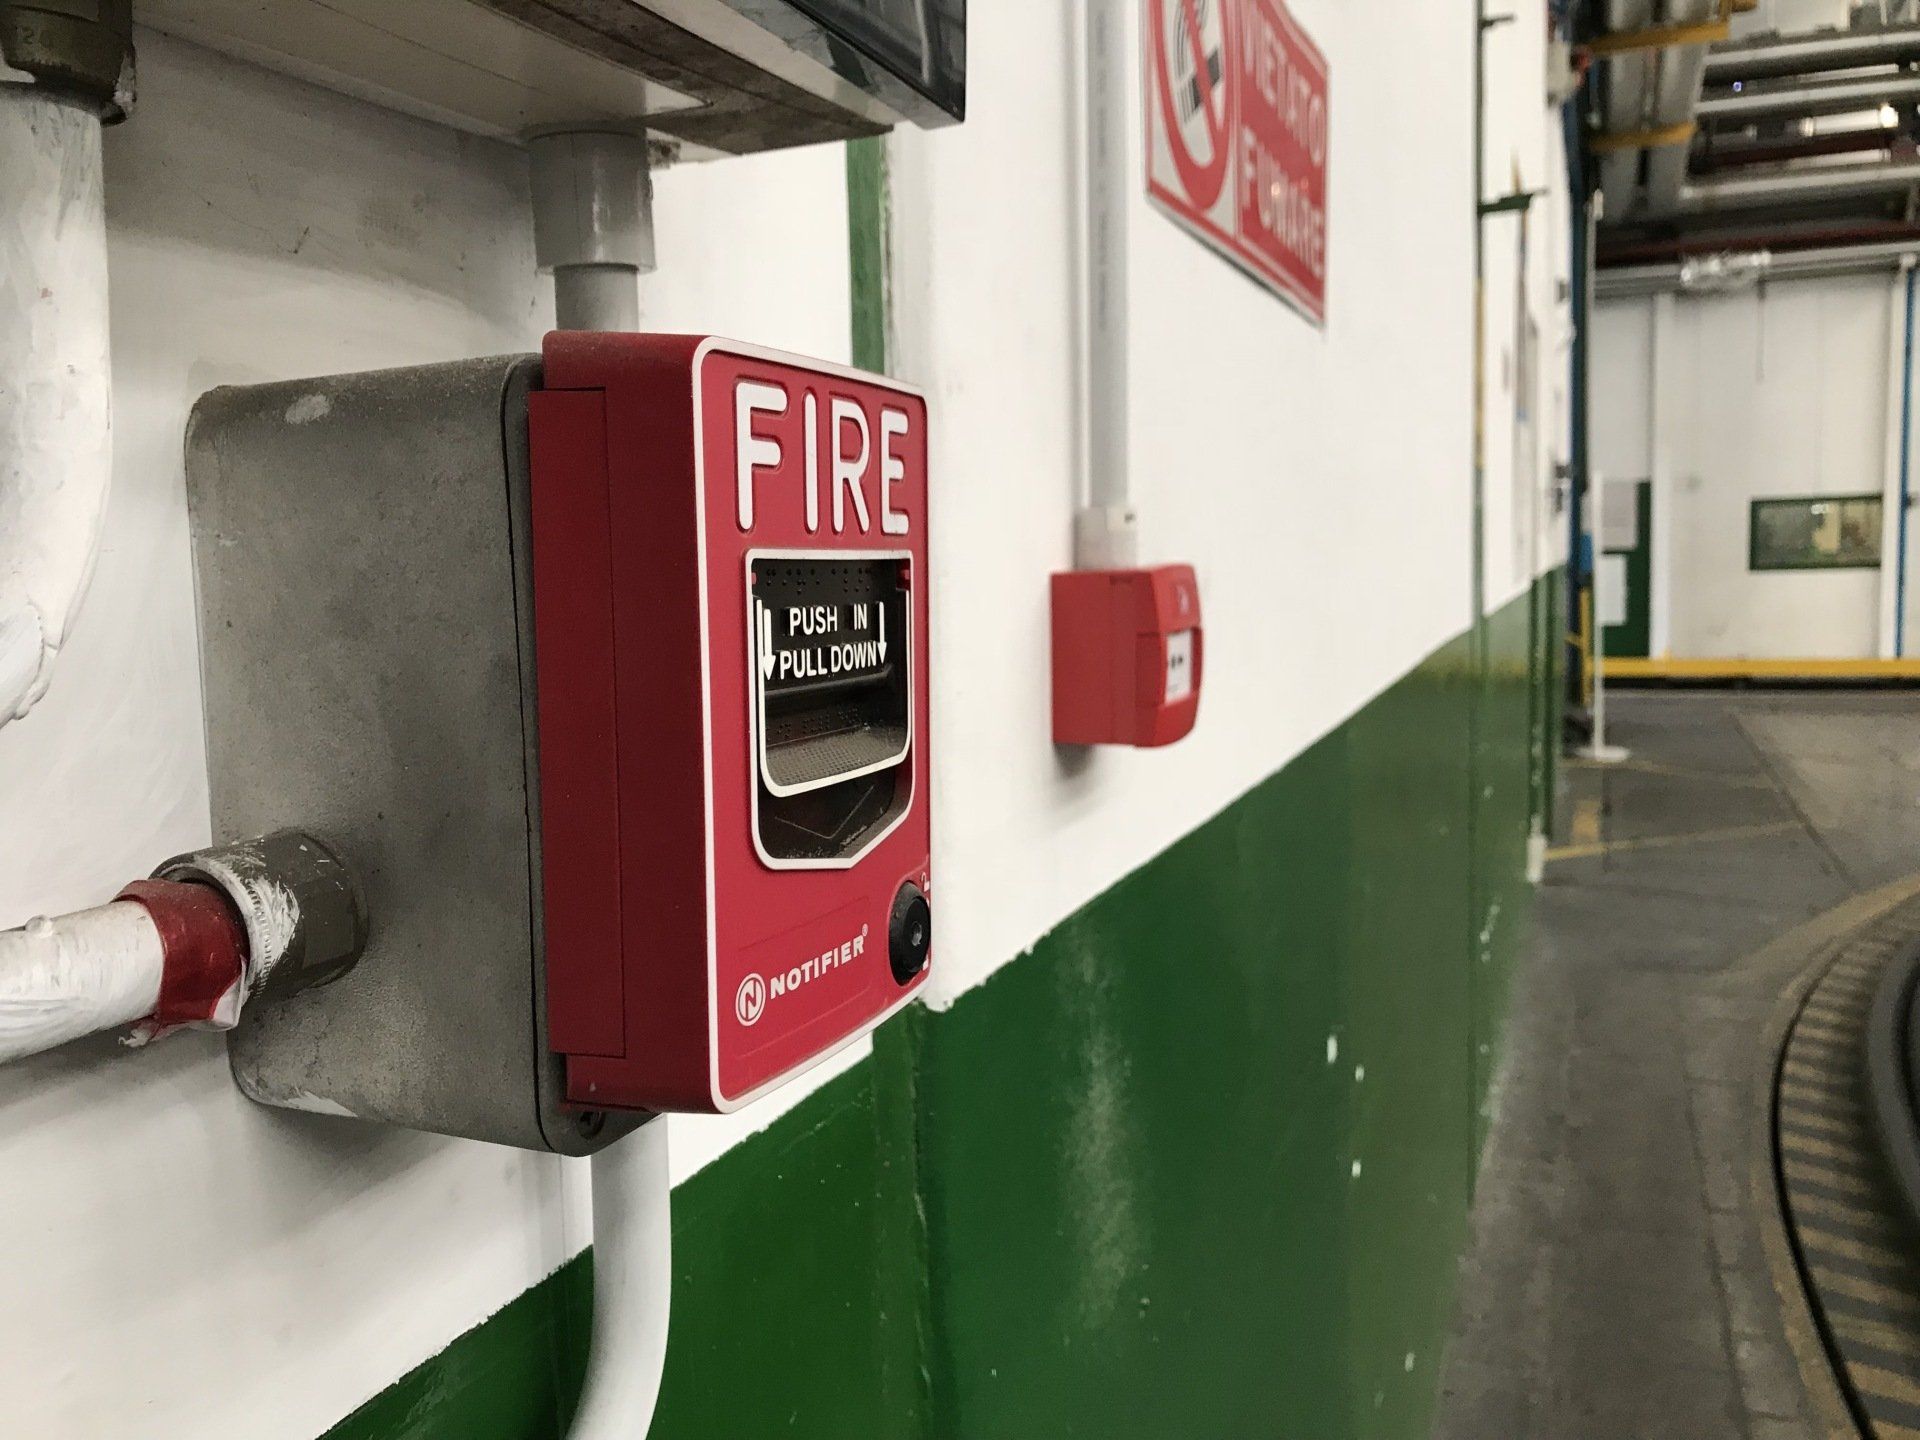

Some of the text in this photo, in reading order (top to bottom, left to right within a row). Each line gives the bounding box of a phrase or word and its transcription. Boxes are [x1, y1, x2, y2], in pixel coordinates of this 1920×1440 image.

[736, 382, 909, 534] FIRE
[789, 603, 867, 636] PUSH IN
[780, 640, 877, 680] PULL DOWN
